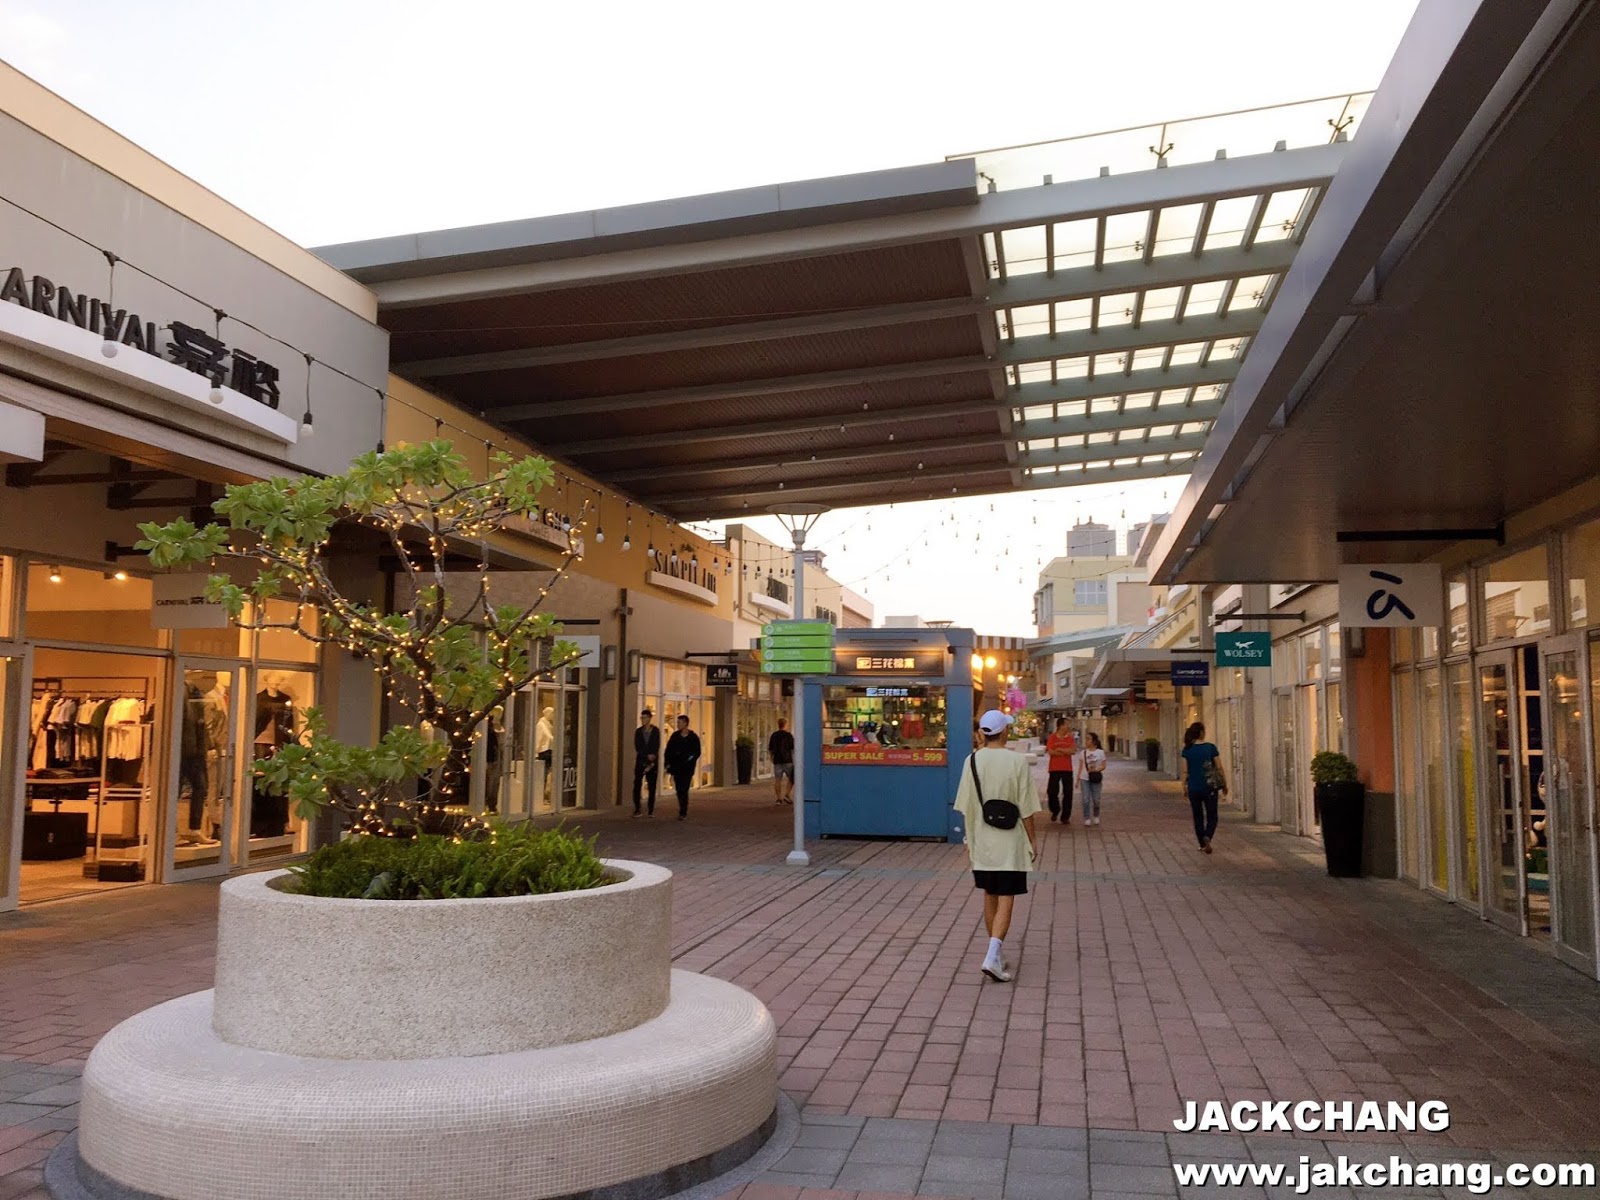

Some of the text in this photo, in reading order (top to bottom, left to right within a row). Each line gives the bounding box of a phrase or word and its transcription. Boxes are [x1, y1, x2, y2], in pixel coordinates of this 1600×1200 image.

[1223, 649, 1265, 658] WOLSEY
[824, 751, 857, 760] SUPER
[860, 752, 885, 760] SALE
